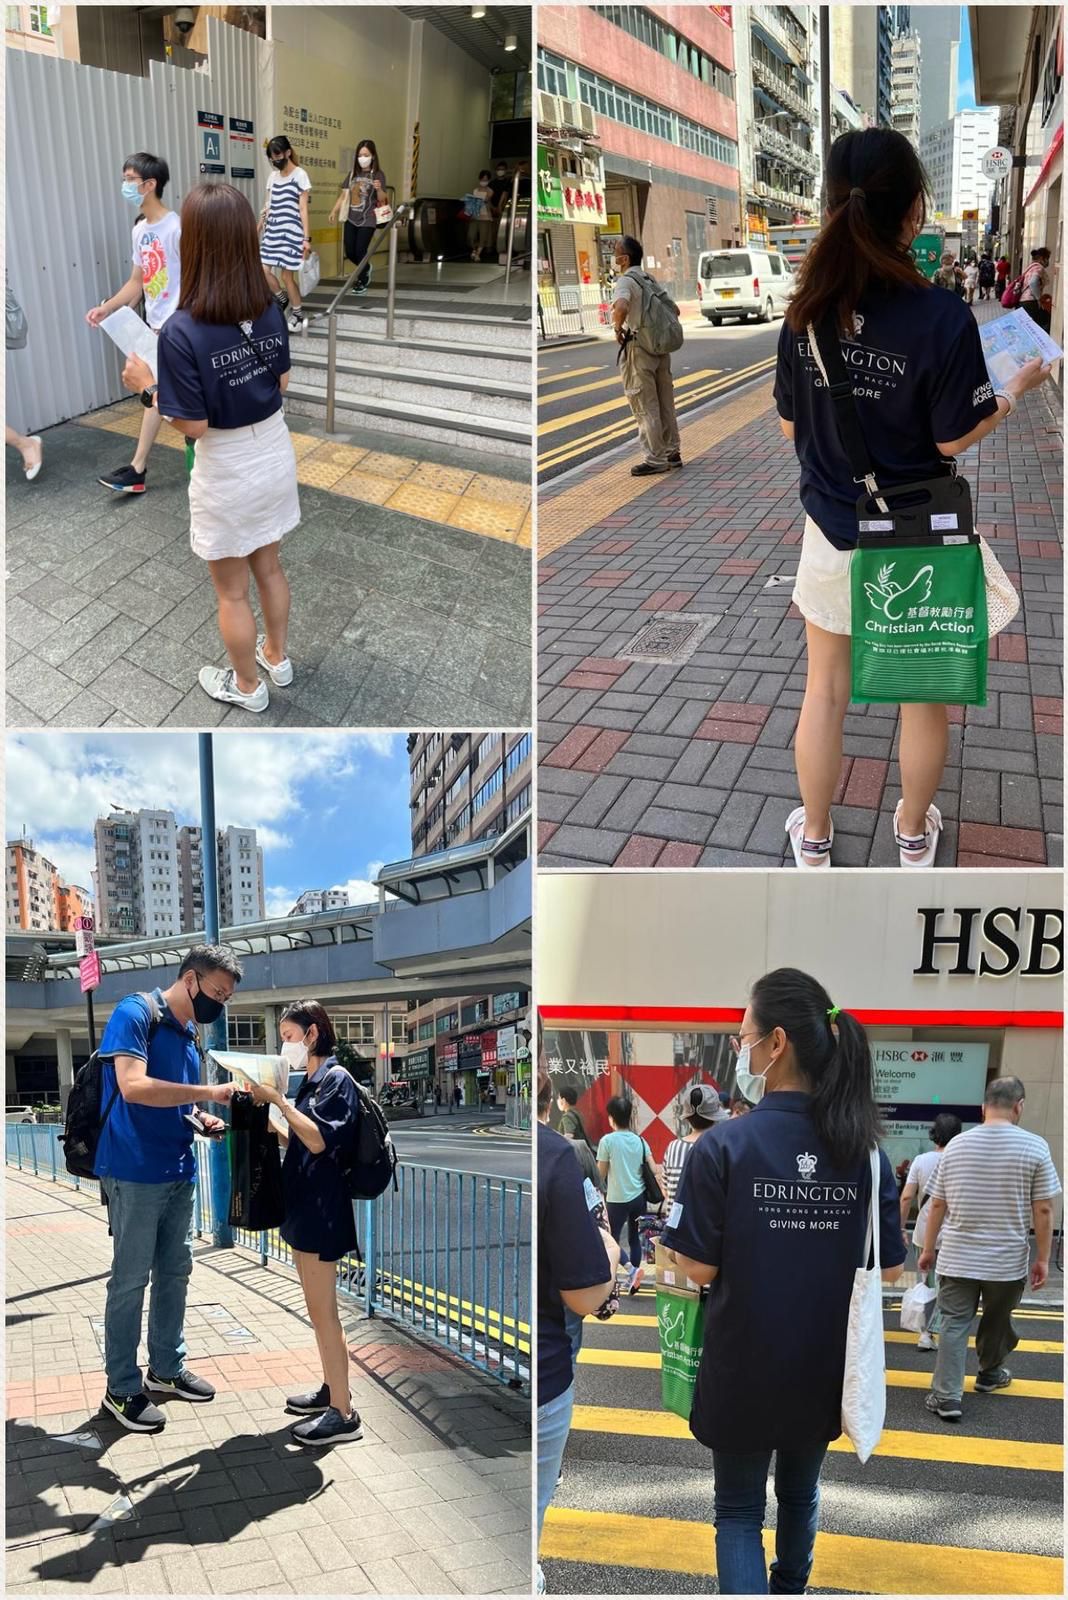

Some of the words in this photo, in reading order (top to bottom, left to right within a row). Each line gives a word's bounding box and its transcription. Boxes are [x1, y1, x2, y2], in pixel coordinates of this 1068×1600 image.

[797, 342, 907, 376] ENGTON
[865, 620, 924, 634] Christian
[928, 620, 975, 634] Action
[876, 1050, 909, 1062] HSBC
[875, 1069, 916, 1079] Welcome
[753, 1183, 857, 1201] EDRINGTON
[769, 1219, 806, 1230] GIVING
[809, 1221, 840, 1230] MORE
